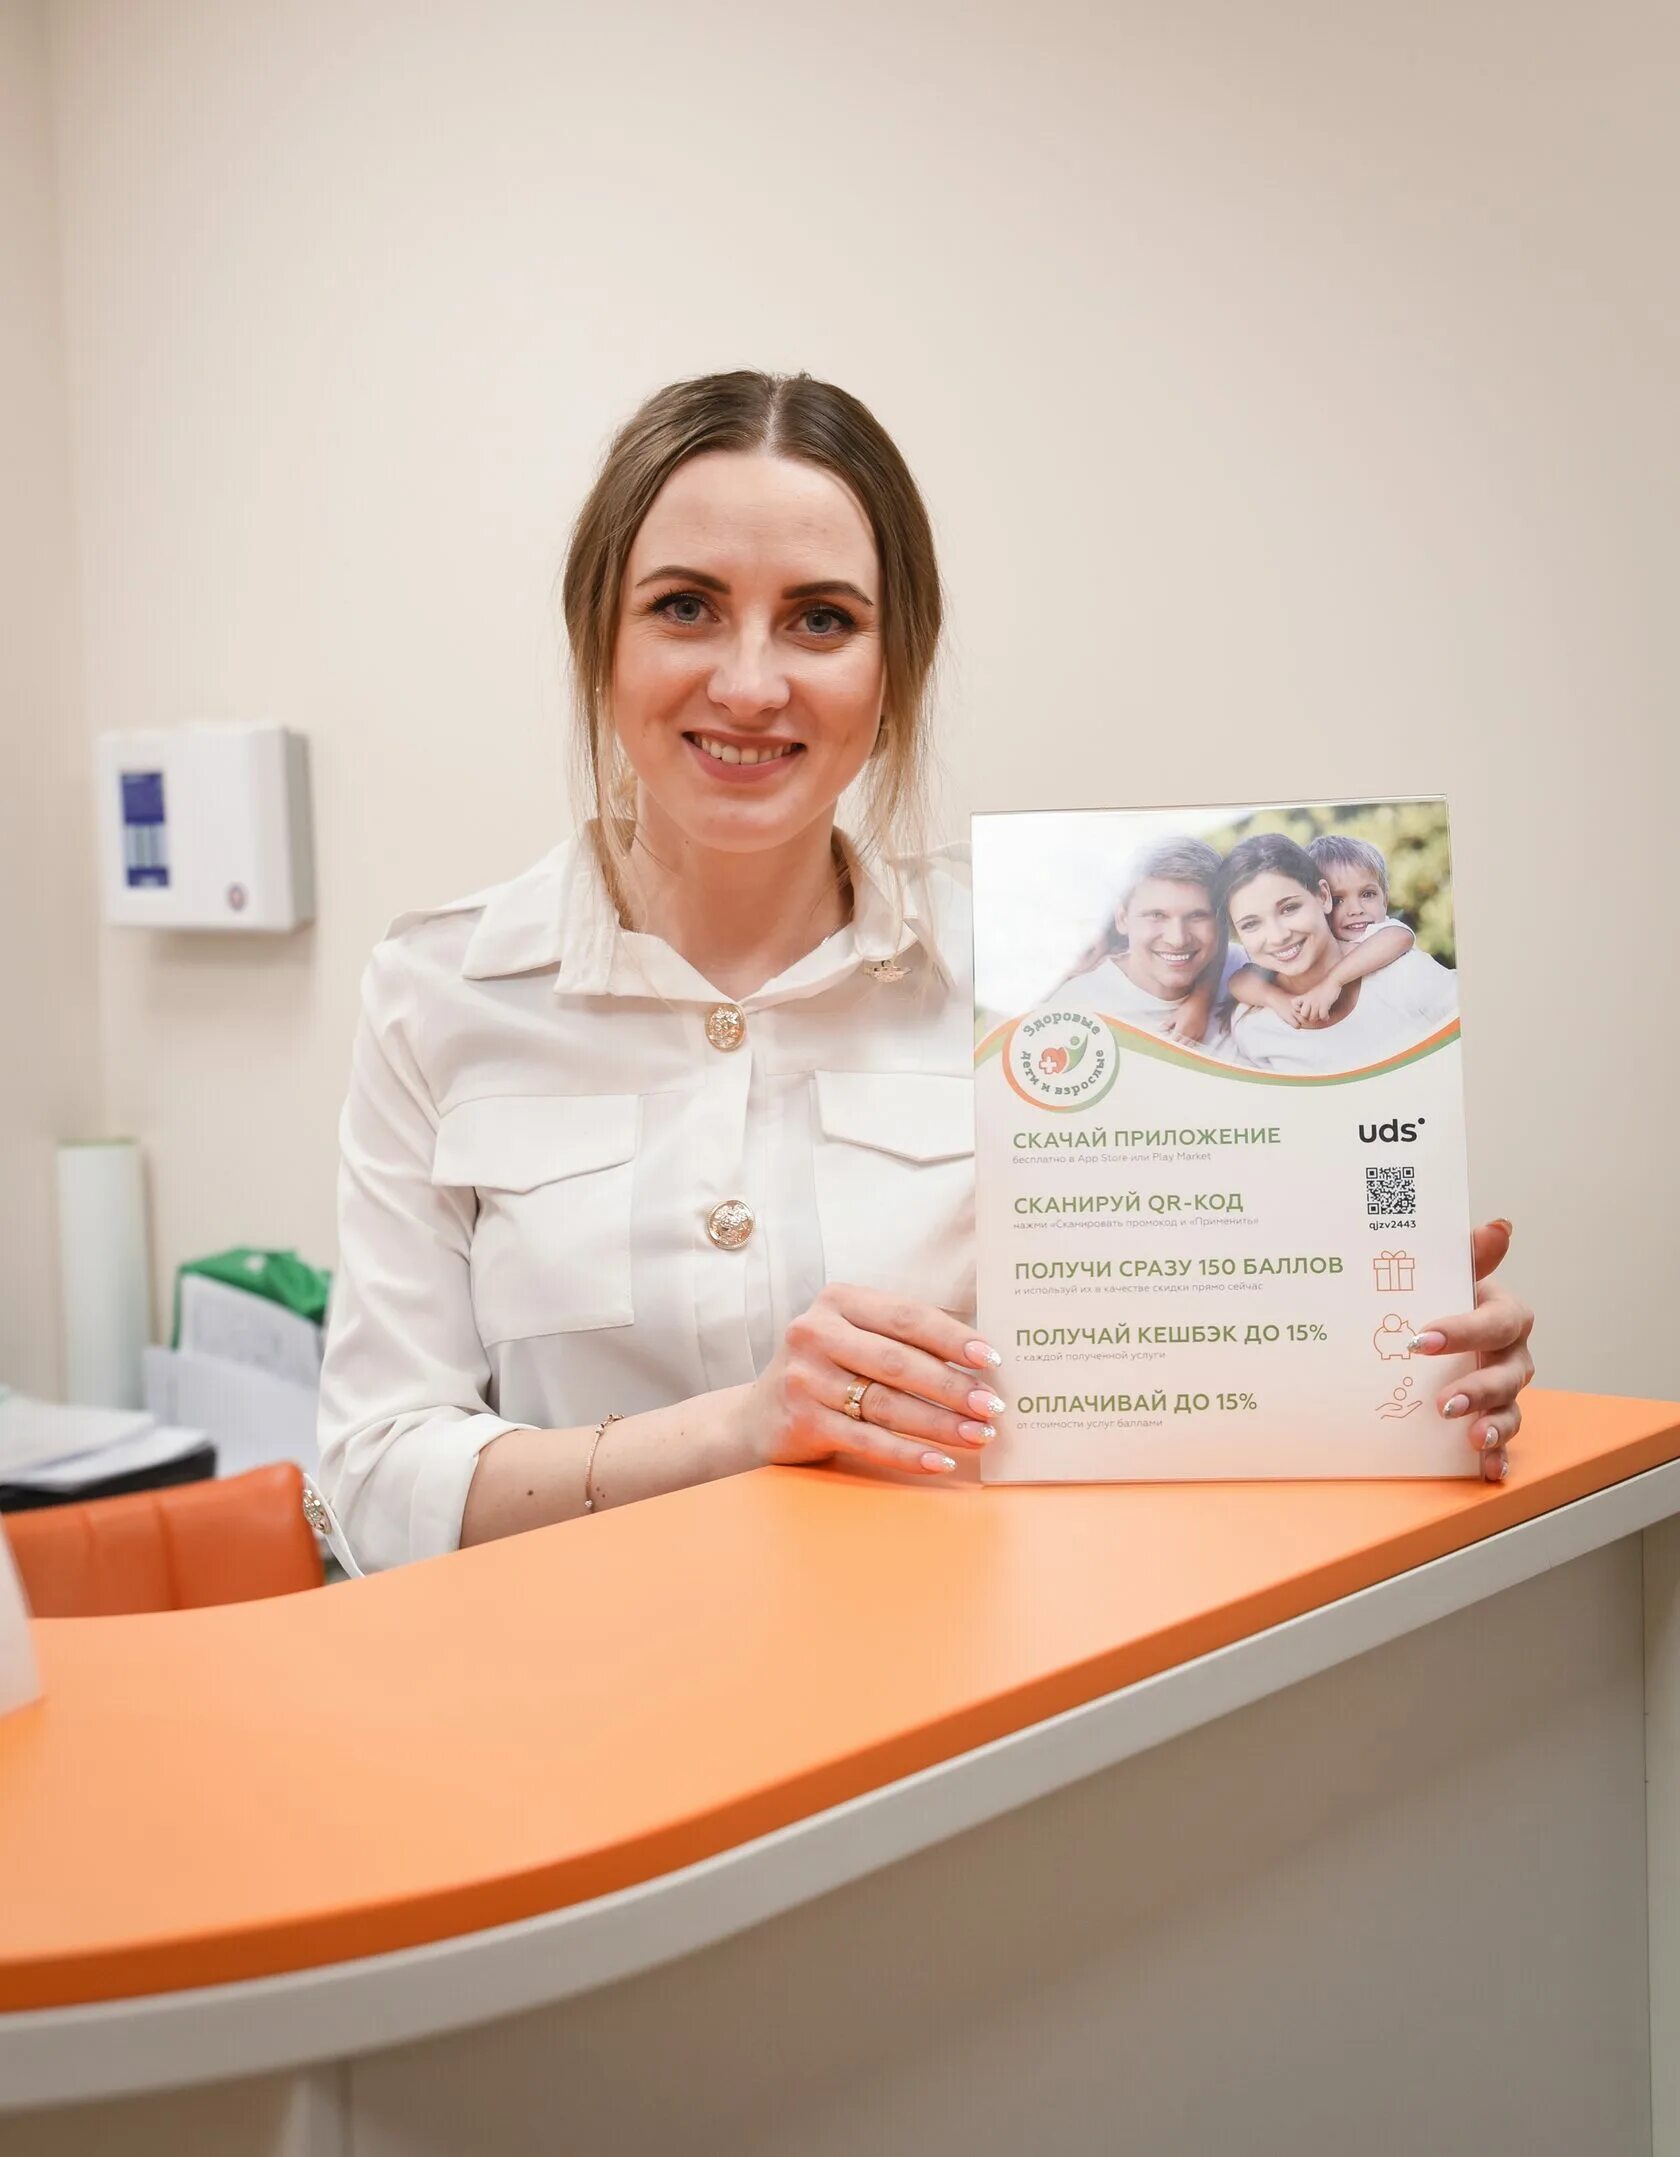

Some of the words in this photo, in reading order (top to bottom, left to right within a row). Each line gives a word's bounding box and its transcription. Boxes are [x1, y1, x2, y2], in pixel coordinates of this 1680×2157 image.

[1023, 1012, 1101, 1037] Здоровые
[1020, 1050, 1039, 1085] дети
[1041, 1083, 1051, 1092] и
[1054, 1049, 1105, 1096] взрослые
[1013, 1127, 1107, 1149] СКАЧАЙ
[1114, 1127, 1281, 1148] ПРИЛОЖЕНИЕ
[1358, 1118, 1418, 1143] uds
[1012, 1154, 1066, 1165] бесплатно
[1077, 1154, 1099, 1165] App
[1100, 1153, 1128, 1163] Store
[1152, 1152, 1174, 1163] Play
[1176, 1152, 1212, 1162] Market
[1014, 1191, 1141, 1214] СКАНИРУЙ
[1148, 1192, 1244, 1214] QR-КОД
[1013, 1222, 1048, 1230] нажми
[1050, 1218, 1123, 1229] «Сканировать
[1126, 1219, 1177, 1229] промокод
[1190, 1216, 1259, 1228] «Применить»
[1369, 1219, 1417, 1231] qjzv2443
[1015, 1261, 1112, 1280] ПОЛУЧИ
[1119, 1259, 1193, 1278] СРАЗУ
[1198, 1258, 1236, 1276] 150
[1243, 1256, 1344, 1276] БАЛЛОВ
[1023, 1284, 1077, 1296] используй
[1080, 1286, 1092, 1294] их
[1104, 1284, 1150, 1294] качестве
[1152, 1283, 1190, 1294] скидки
[1192, 1282, 1225, 1293] прямо
[1227, 1281, 1264, 1291] сейчас
[1016, 1323, 1131, 1347] ПОЛУЧАЙ
[1137, 1325, 1238, 1344] КЕШБЭК
[1243, 1324, 1280, 1345] ДО
[1286, 1324, 1329, 1342] 15%
[1023, 1352, 1063, 1362] каждой
[1065, 1351, 1128, 1362] полученной
[1130, 1351, 1166, 1362] услуги
[1017, 1390, 1167, 1414] ОПЛАЧИВАЙ
[1173, 1393, 1210, 1414] ДО
[1216, 1392, 1258, 1411] 15%
[1016, 1422, 1027, 1430] от
[1029, 1420, 1084, 1430] стоимости
[1086, 1420, 1114, 1431] услуг
[1116, 1418, 1163, 1428] баллами
